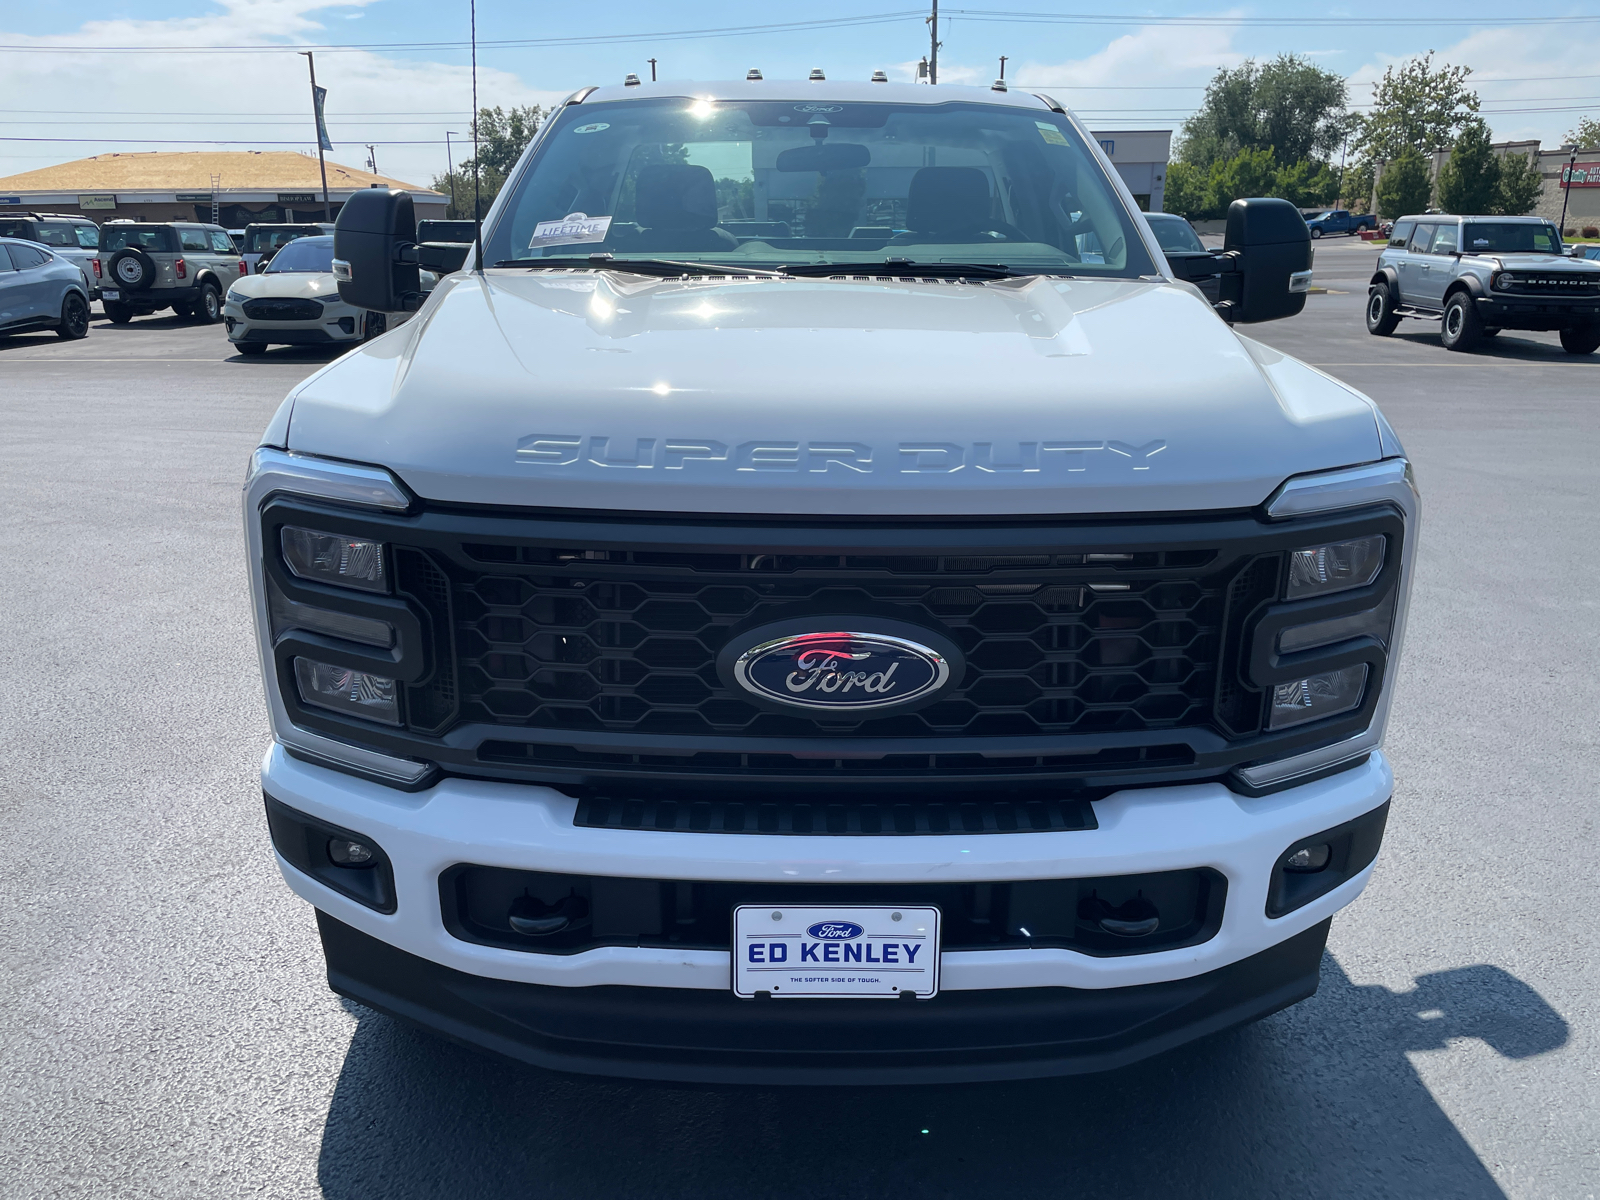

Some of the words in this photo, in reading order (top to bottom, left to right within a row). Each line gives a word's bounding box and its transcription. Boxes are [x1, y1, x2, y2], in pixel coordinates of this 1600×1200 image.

[541, 223, 600, 237] LIFETIME
[514, 433, 874, 473] SUPER
[898, 440, 1167, 473] DUTY
[785, 649, 899, 693] Ford
[818, 924, 852, 938] Ford
[748, 943, 788, 963] ED
[801, 942, 922, 964] KENLEY
